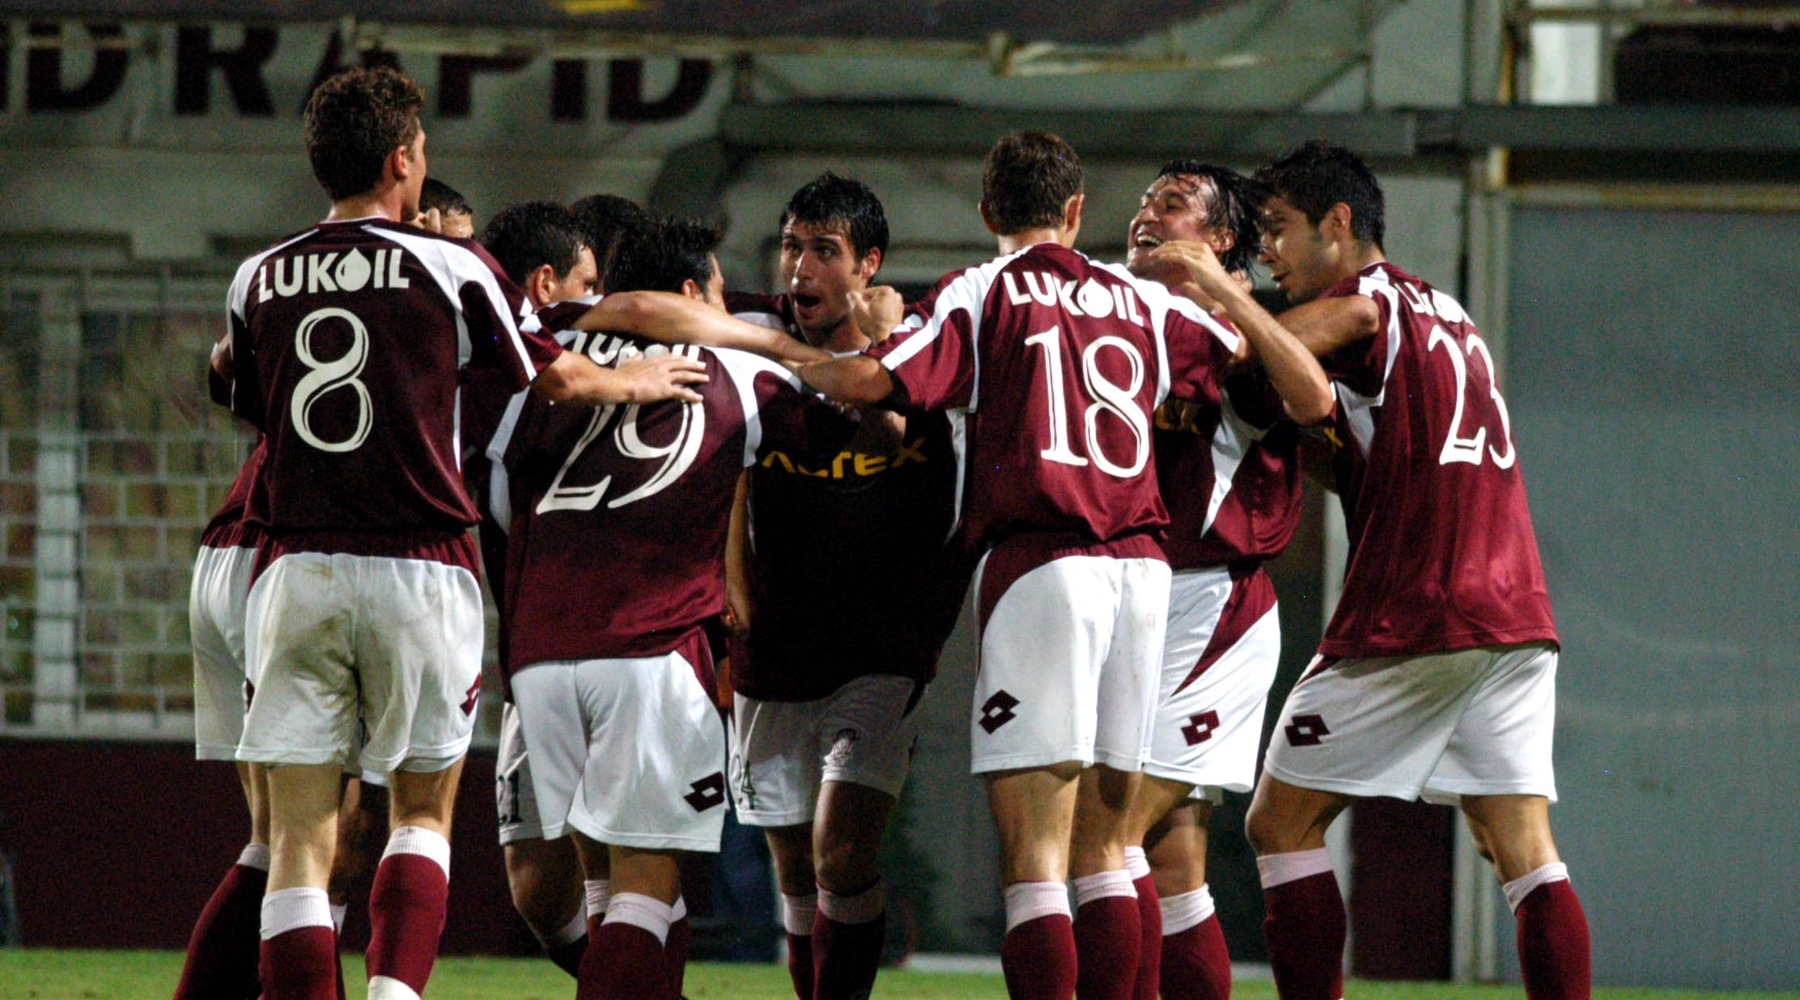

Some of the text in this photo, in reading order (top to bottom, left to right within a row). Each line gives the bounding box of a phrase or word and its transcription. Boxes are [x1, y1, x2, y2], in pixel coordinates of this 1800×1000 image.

[258, 247, 409, 303] LUKOIL
[1002, 271, 1144, 327] LUKOIL
[291, 307, 373, 452] 8
[1024, 325, 1150, 478] 18
[1428, 324, 1515, 470] 23
[535, 399, 706, 516] 29
